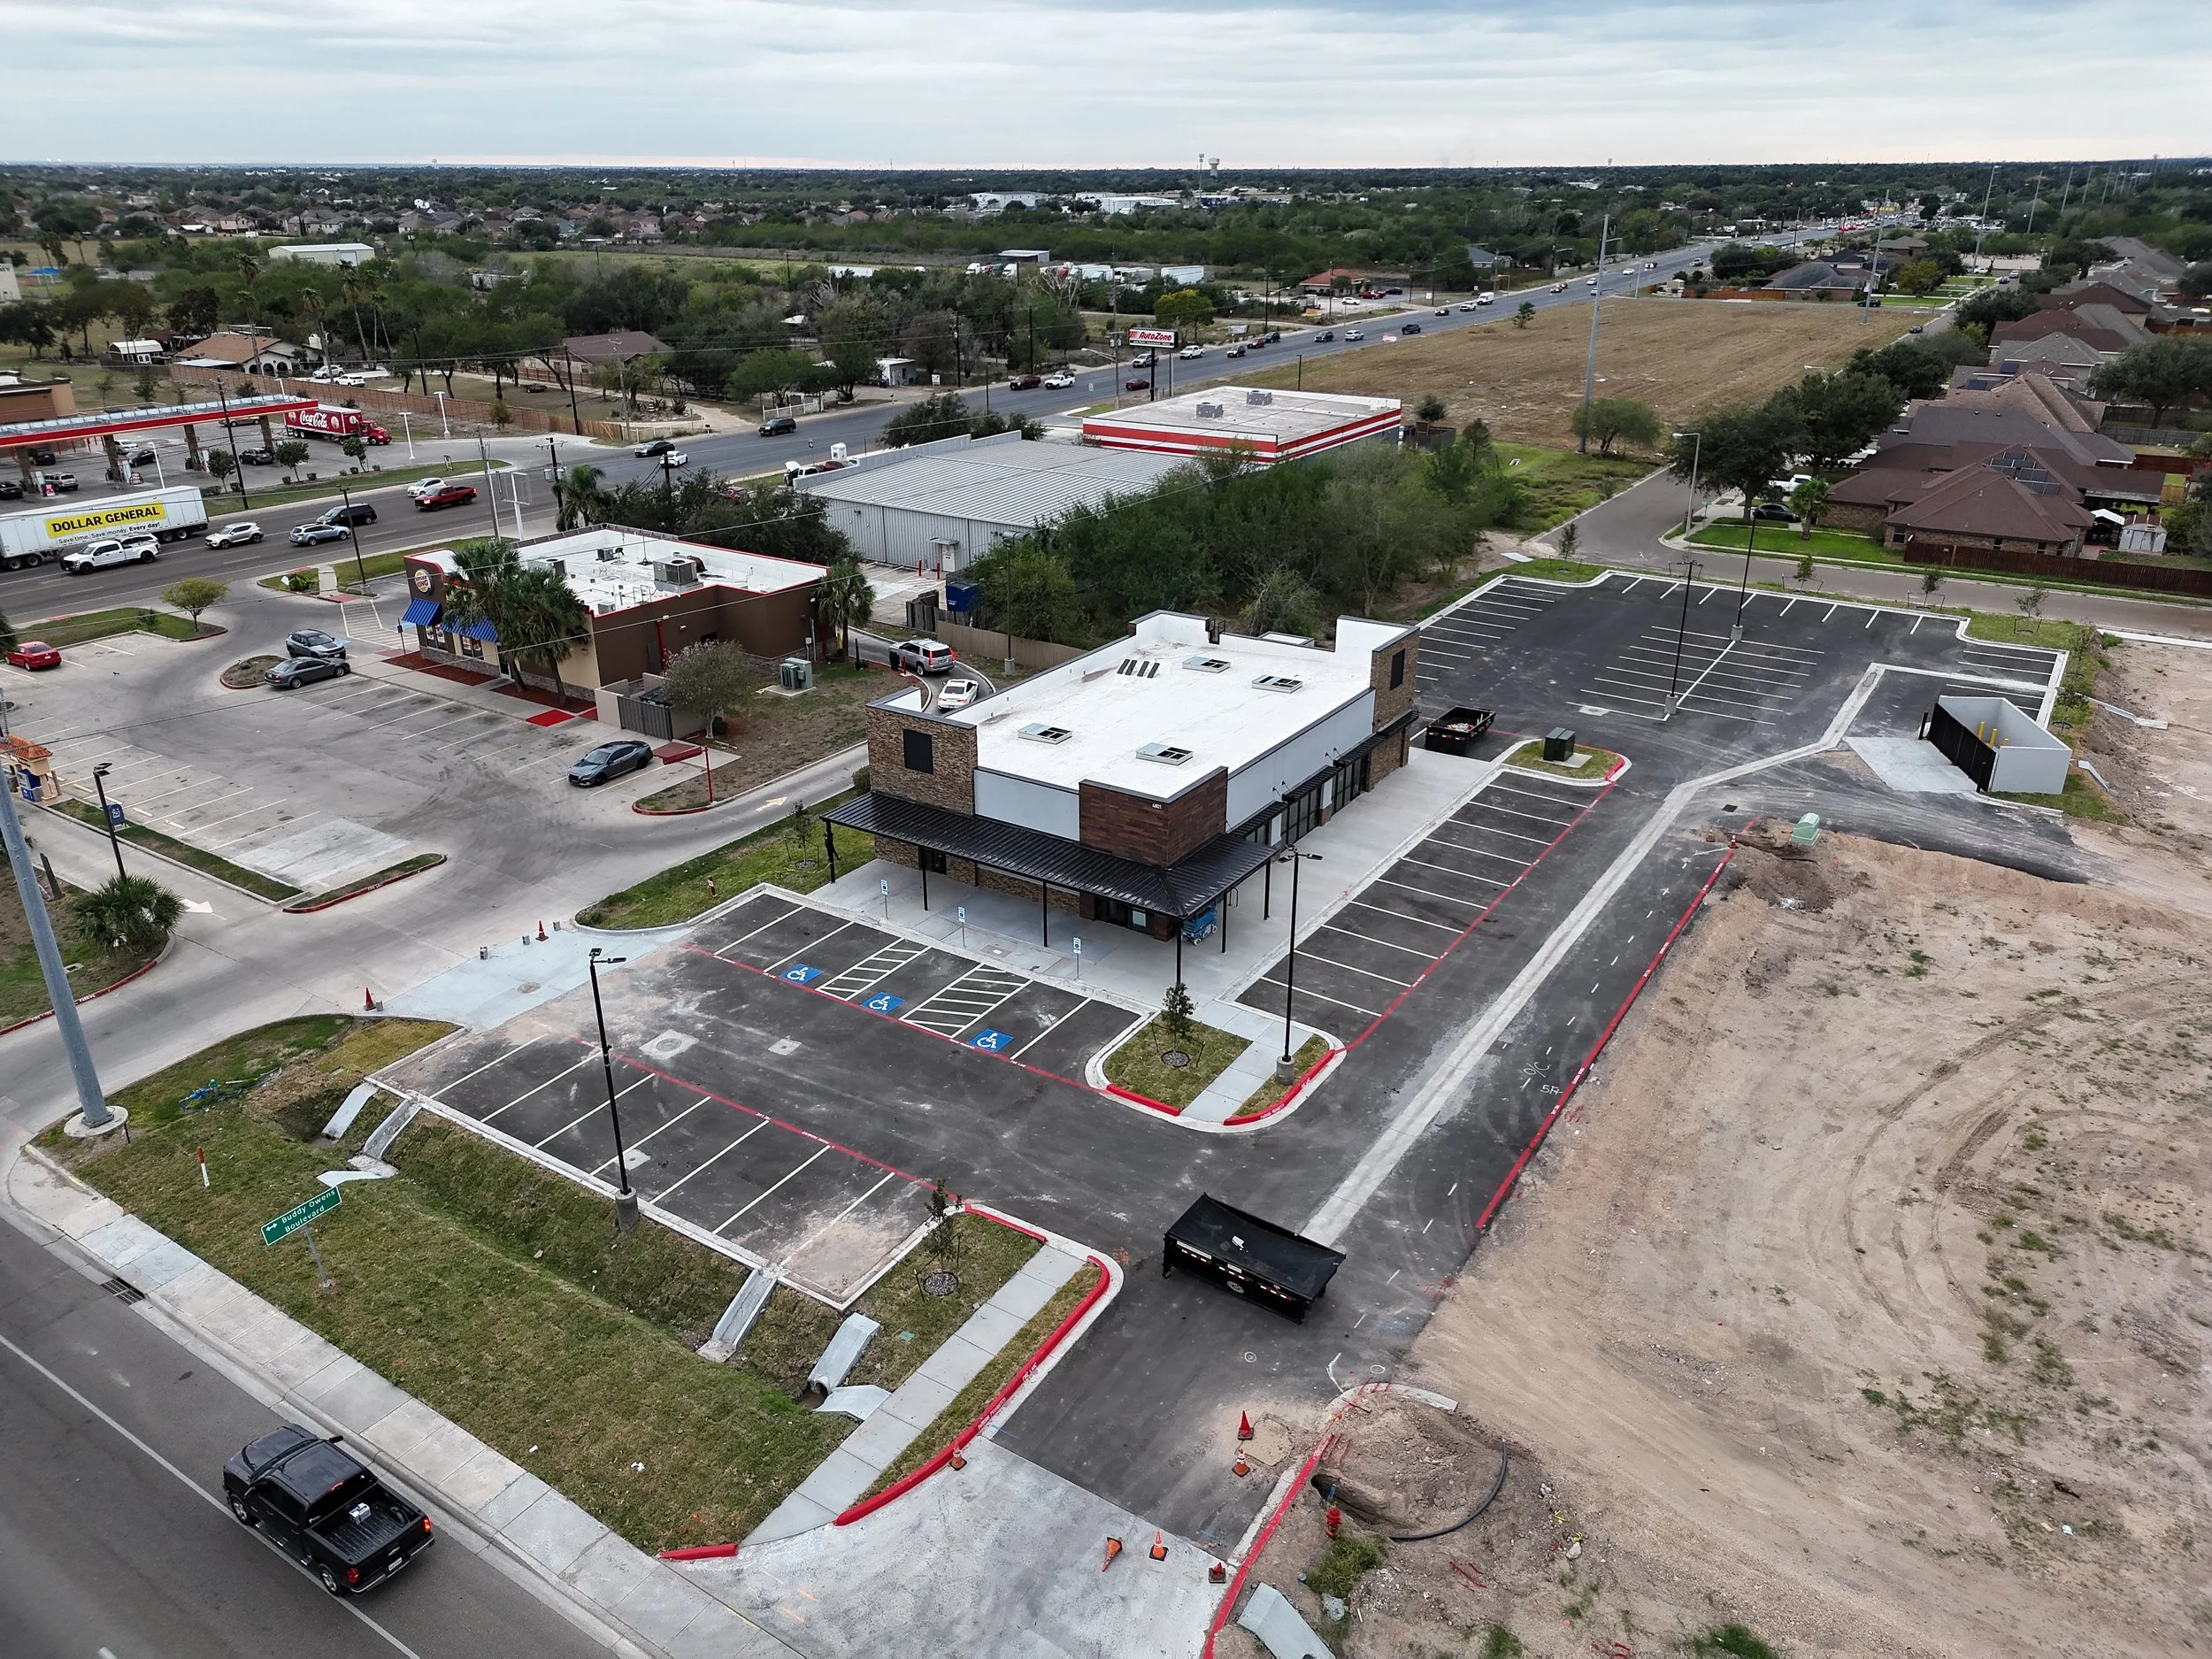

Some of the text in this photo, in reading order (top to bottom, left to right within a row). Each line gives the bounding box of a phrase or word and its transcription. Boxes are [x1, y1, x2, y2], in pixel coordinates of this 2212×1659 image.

[1139, 331, 1172, 341] AutoZone
[51, 506, 160, 533] DOLLAR GENERAL
[281, 1190, 335, 1224] Buddy Owens
[285, 1205, 325, 1233] Boulevard
